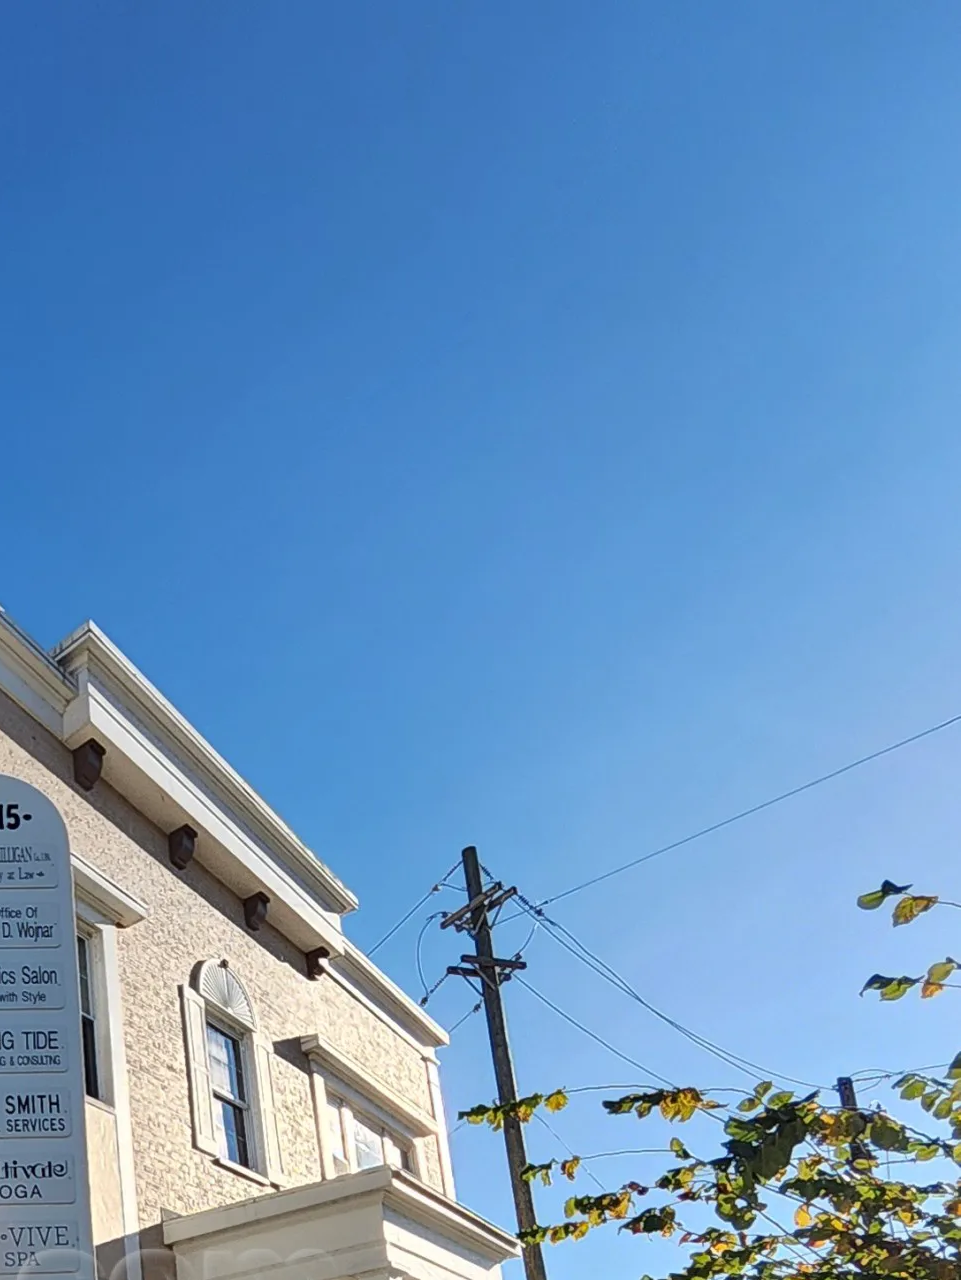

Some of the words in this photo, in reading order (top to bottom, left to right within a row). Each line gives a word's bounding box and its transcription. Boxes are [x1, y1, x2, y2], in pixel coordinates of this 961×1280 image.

[18, 867, 34, 880] Law
[26, 907, 38, 919] Of
[2, 922, 13, 939] D.
[17, 922, 54, 942] Wojnar
[21, 965, 58, 985] Salon
[22, 990, 46, 1005] Style
[22, 1030, 59, 1050] TIDE
[9, 1056, 15, 1066] &
[17, 1055, 61, 1066] CONSULTING
[5, 1094, 61, 1115] SMITH
[6, 1118, 66, 1132] SERVICES
[5, 1251, 41, 1267] SPA
